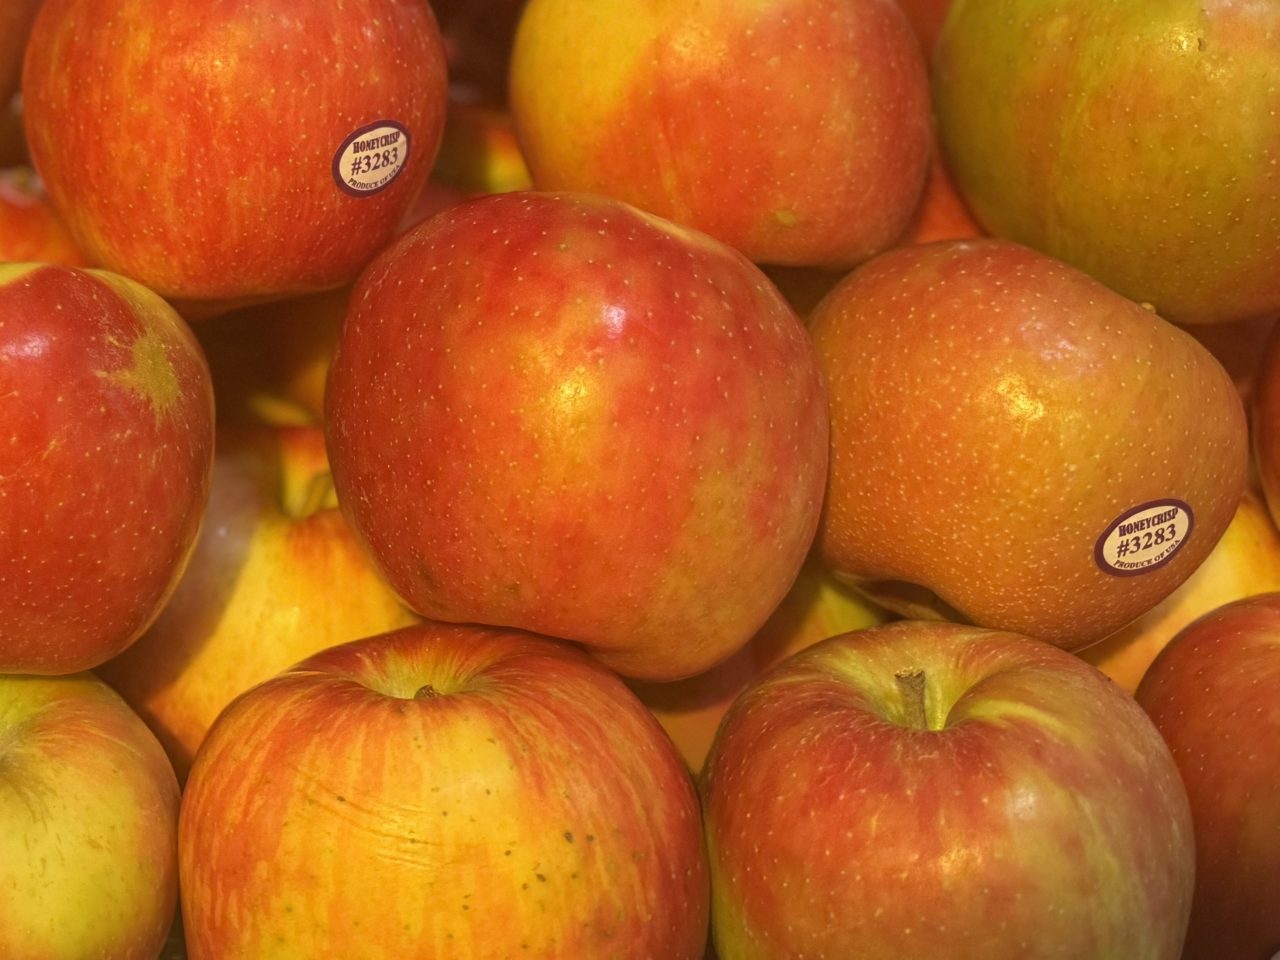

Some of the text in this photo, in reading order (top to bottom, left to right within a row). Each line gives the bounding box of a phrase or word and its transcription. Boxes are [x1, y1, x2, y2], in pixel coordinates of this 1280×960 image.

[353, 130, 401, 154] HONEYCRISP
[351, 146, 399, 176] #3283
[347, 177, 379, 190] PRODUCE
[1118, 506, 1179, 537] HONEYCRISP
[1113, 539, 1181, 569] PRODUCE OF USA
[1116, 523, 1176, 558] #3283
